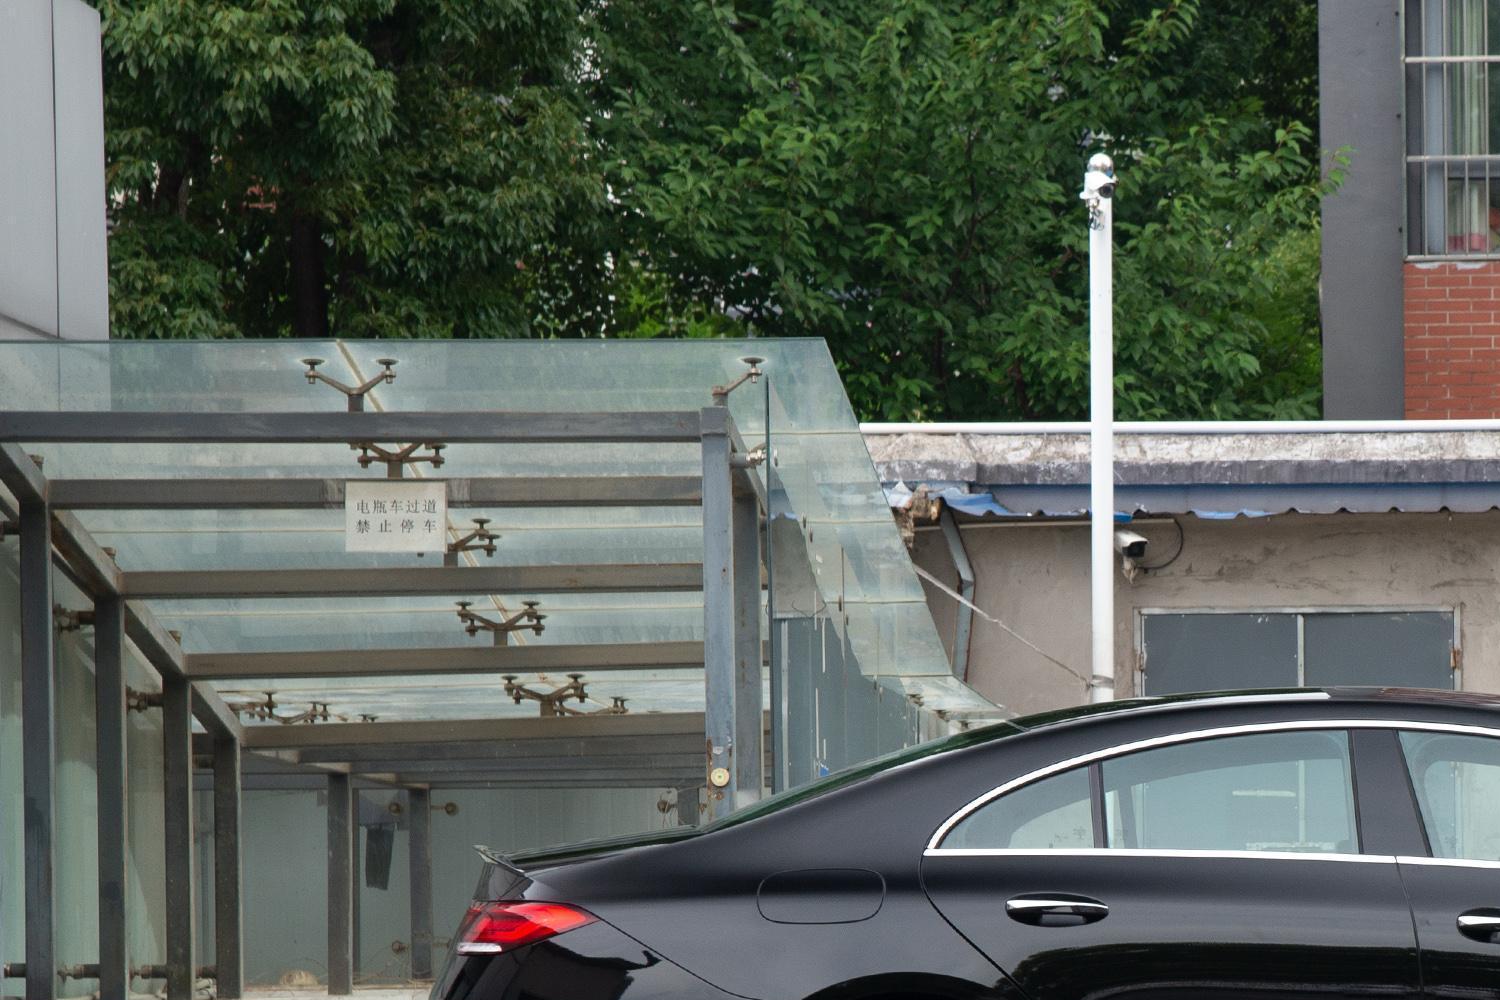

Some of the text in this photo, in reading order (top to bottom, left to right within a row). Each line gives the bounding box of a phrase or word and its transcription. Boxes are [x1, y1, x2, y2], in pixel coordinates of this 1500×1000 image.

[356, 499, 437, 514] 电瓶车过道
[356, 519, 437, 534] 禁止停车
